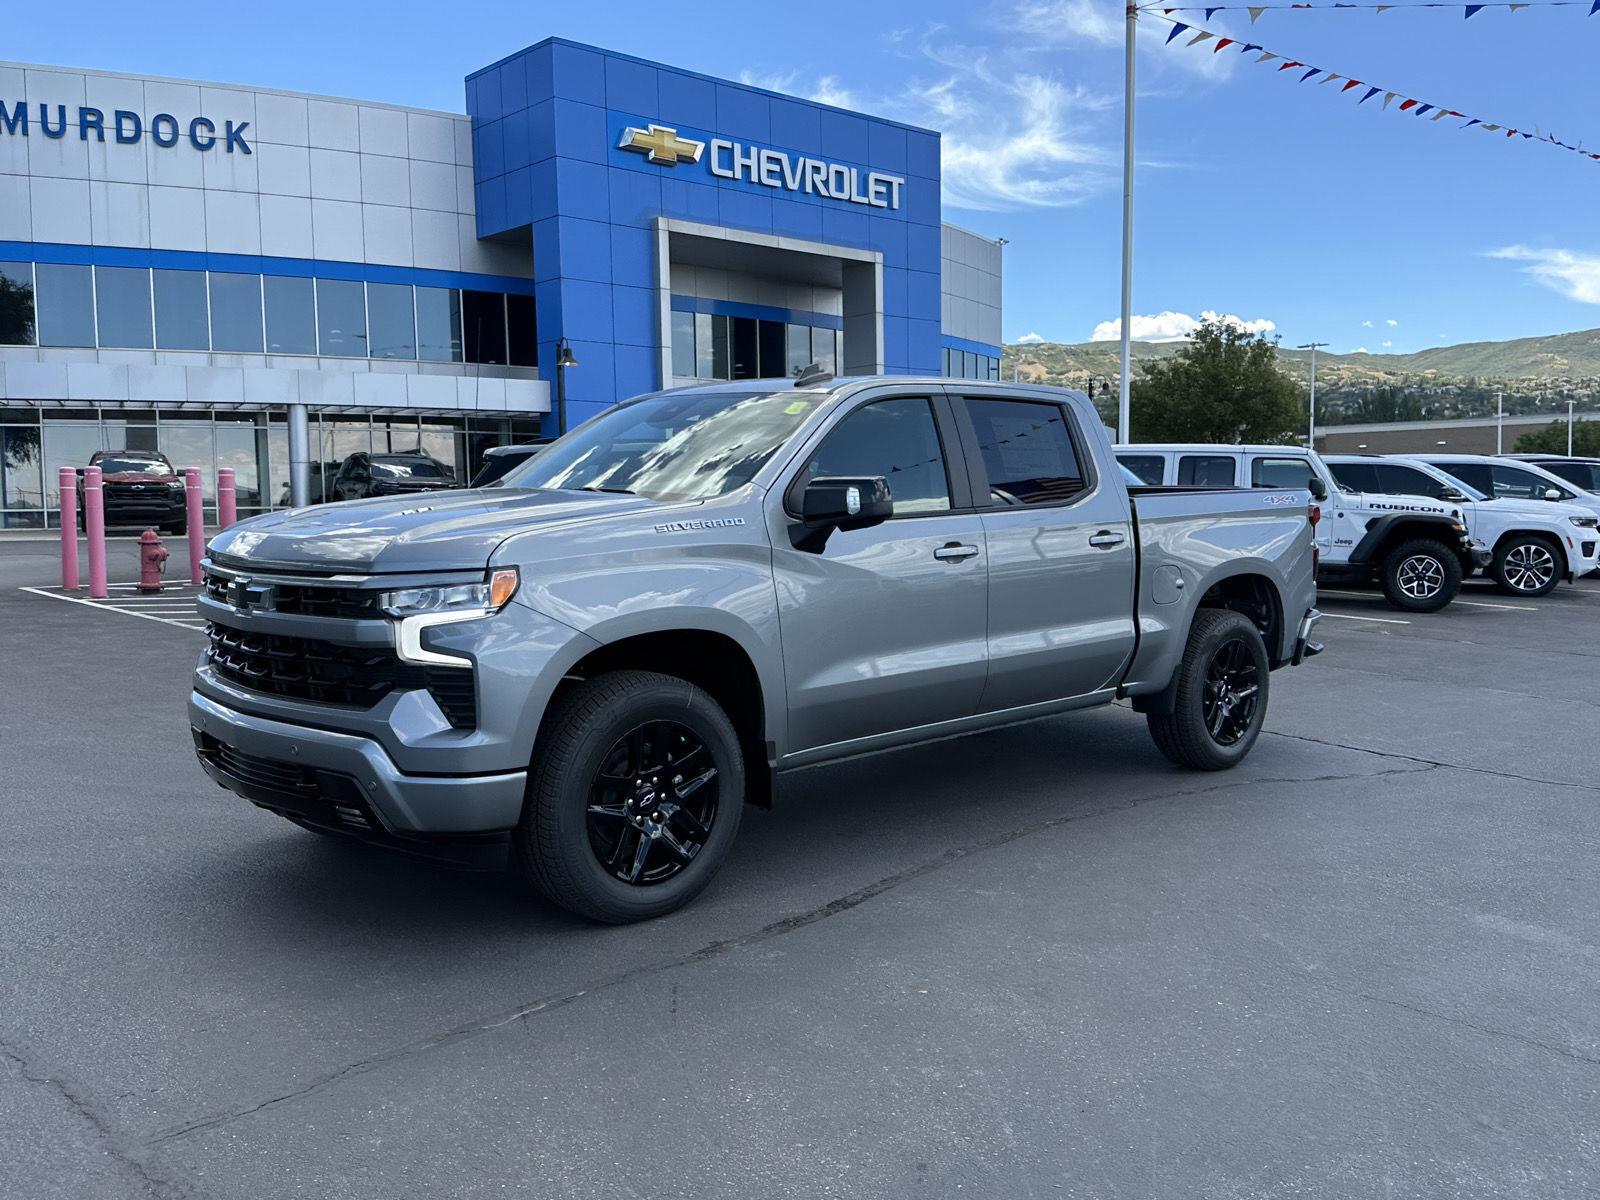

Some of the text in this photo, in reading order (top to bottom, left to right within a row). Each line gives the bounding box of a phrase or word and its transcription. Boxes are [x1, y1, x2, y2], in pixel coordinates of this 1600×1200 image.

[0, 101, 252, 155] MURDOCK
[710, 138, 905, 209] CHEVROLET
[1369, 503, 1445, 513] RUBICON
[654, 517, 745, 533] SILVERADO
[1334, 537, 1353, 546] Jeep
